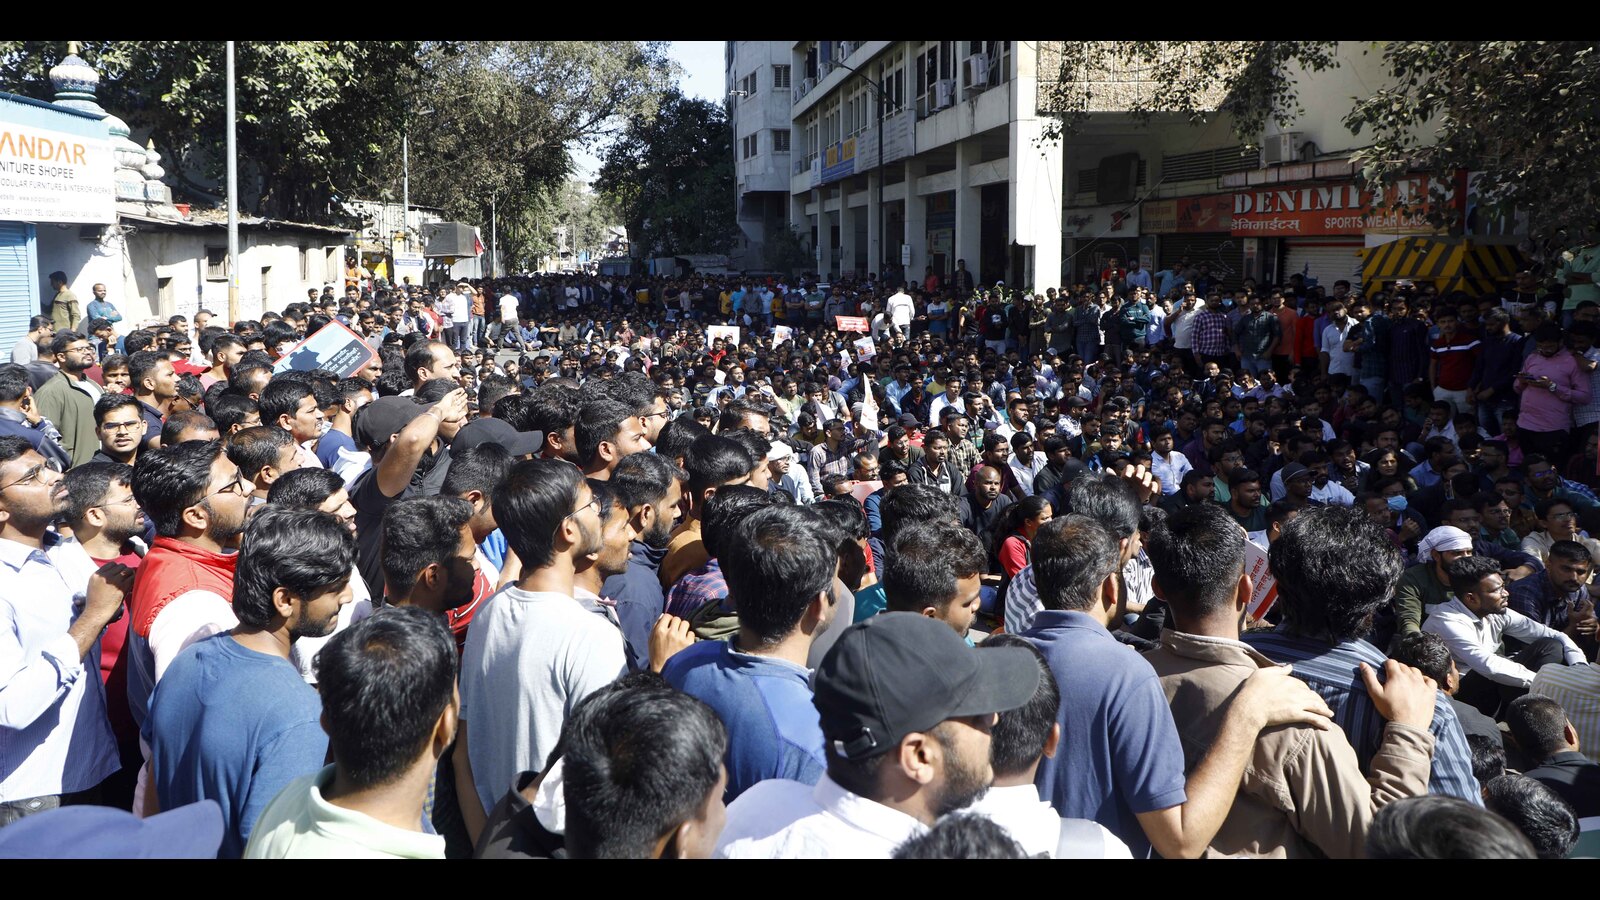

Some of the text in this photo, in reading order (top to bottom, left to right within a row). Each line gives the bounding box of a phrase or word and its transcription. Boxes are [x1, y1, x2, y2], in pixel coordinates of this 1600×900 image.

[0, 131, 87, 166] ANDAR
[38, 165, 74, 179] SHOPEE
[29, 181, 62, 191] FURNITURE
[1324, 215, 1363, 230] SPORTS
[1366, 215, 1397, 229] WEAR
